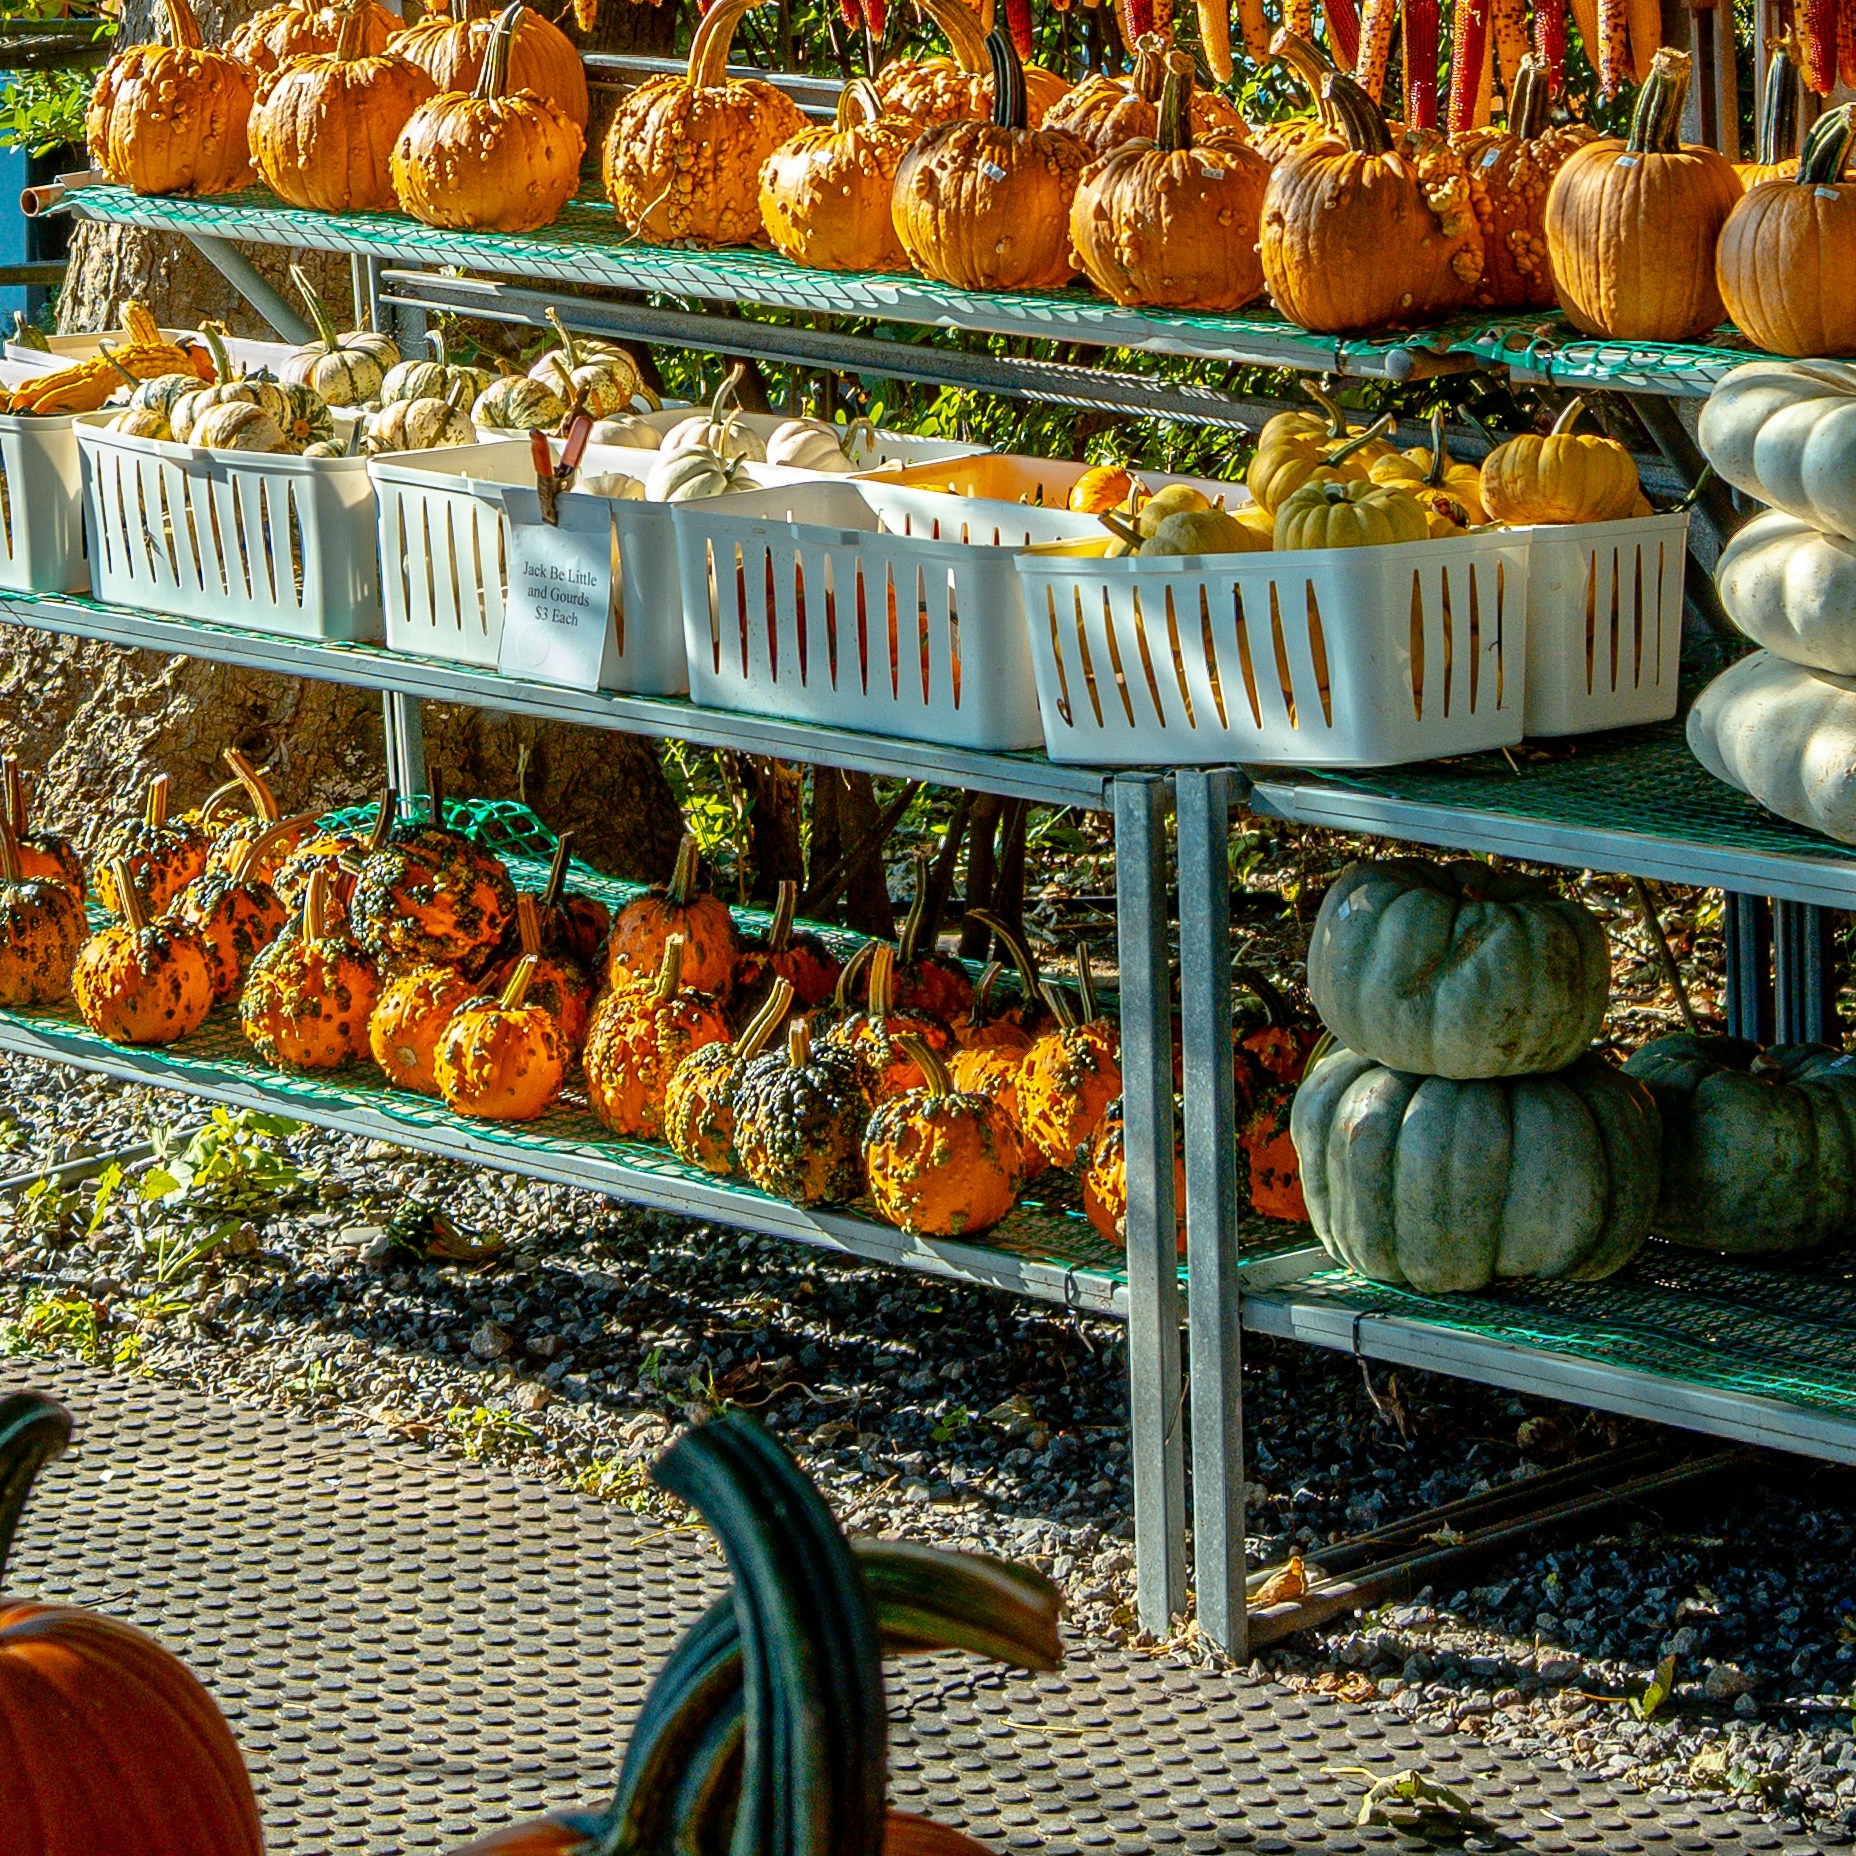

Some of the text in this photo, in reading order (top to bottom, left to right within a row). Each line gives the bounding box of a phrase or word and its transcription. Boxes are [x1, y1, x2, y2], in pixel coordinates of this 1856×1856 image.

[523, 561, 598, 587] Jack Be Little
[528, 585, 591, 607] and Gourds
[535, 605, 578, 626] $3 Each
